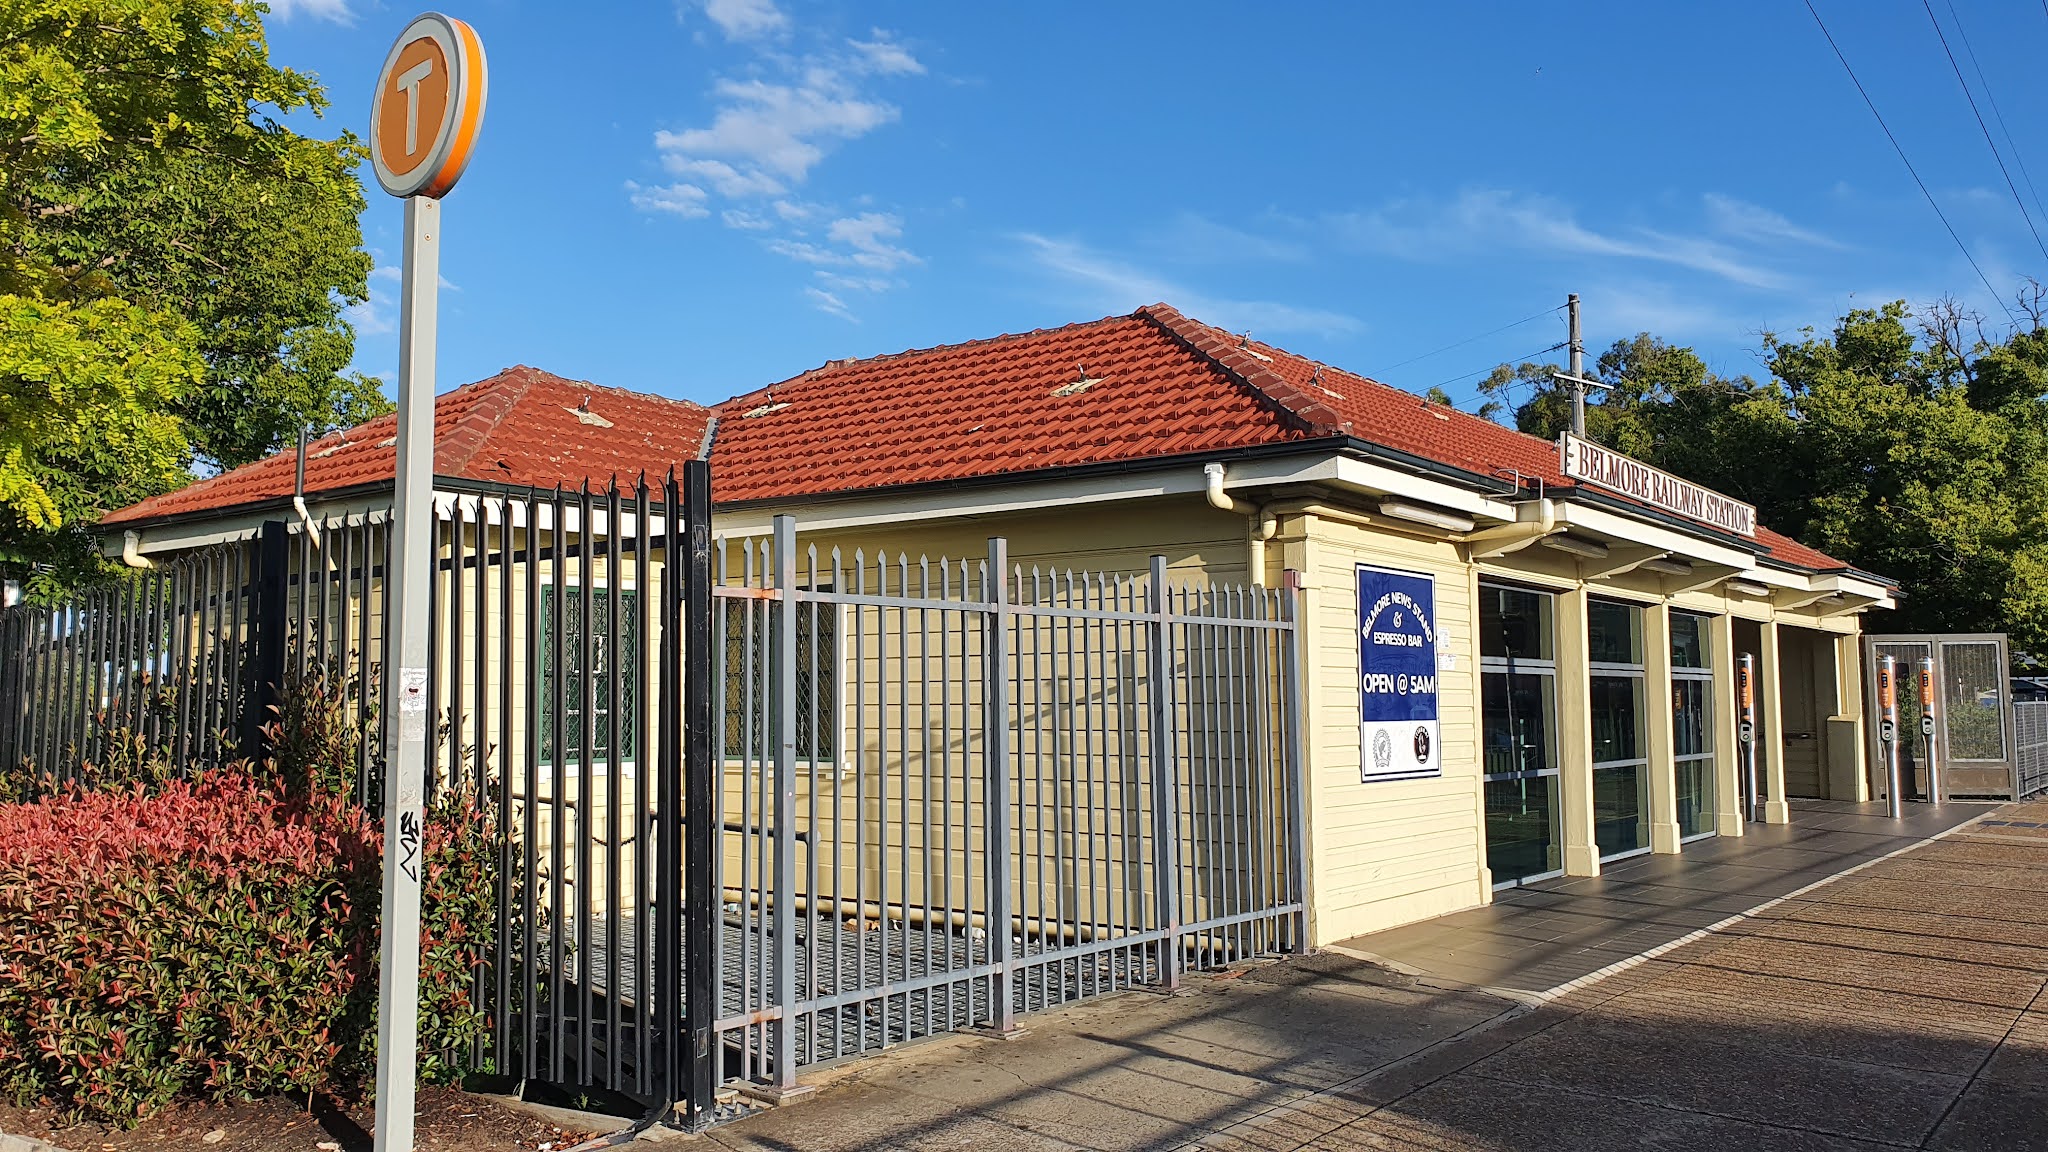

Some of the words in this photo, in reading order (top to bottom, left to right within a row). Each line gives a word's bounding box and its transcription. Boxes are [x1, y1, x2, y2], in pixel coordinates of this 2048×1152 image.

[397, 58, 432, 157] T
[1578, 442, 1650, 498] BELMORE
[1651, 472, 1705, 518] RAILWAY
[1706, 495, 1749, 533] STATION
[1362, 594, 1391, 639] BELMORE
[1391, 592, 1412, 609] NEWS
[1412, 602, 1433, 643] STAND
[1393, 611, 1402, 628] &
[1373, 631, 1407, 646] ESPRESSO
[1407, 634, 1423, 647] BAR
[1363, 673, 1394, 694] OPEN
[1397, 673, 1408, 696] @
[1410, 676, 1435, 694] 5AM
